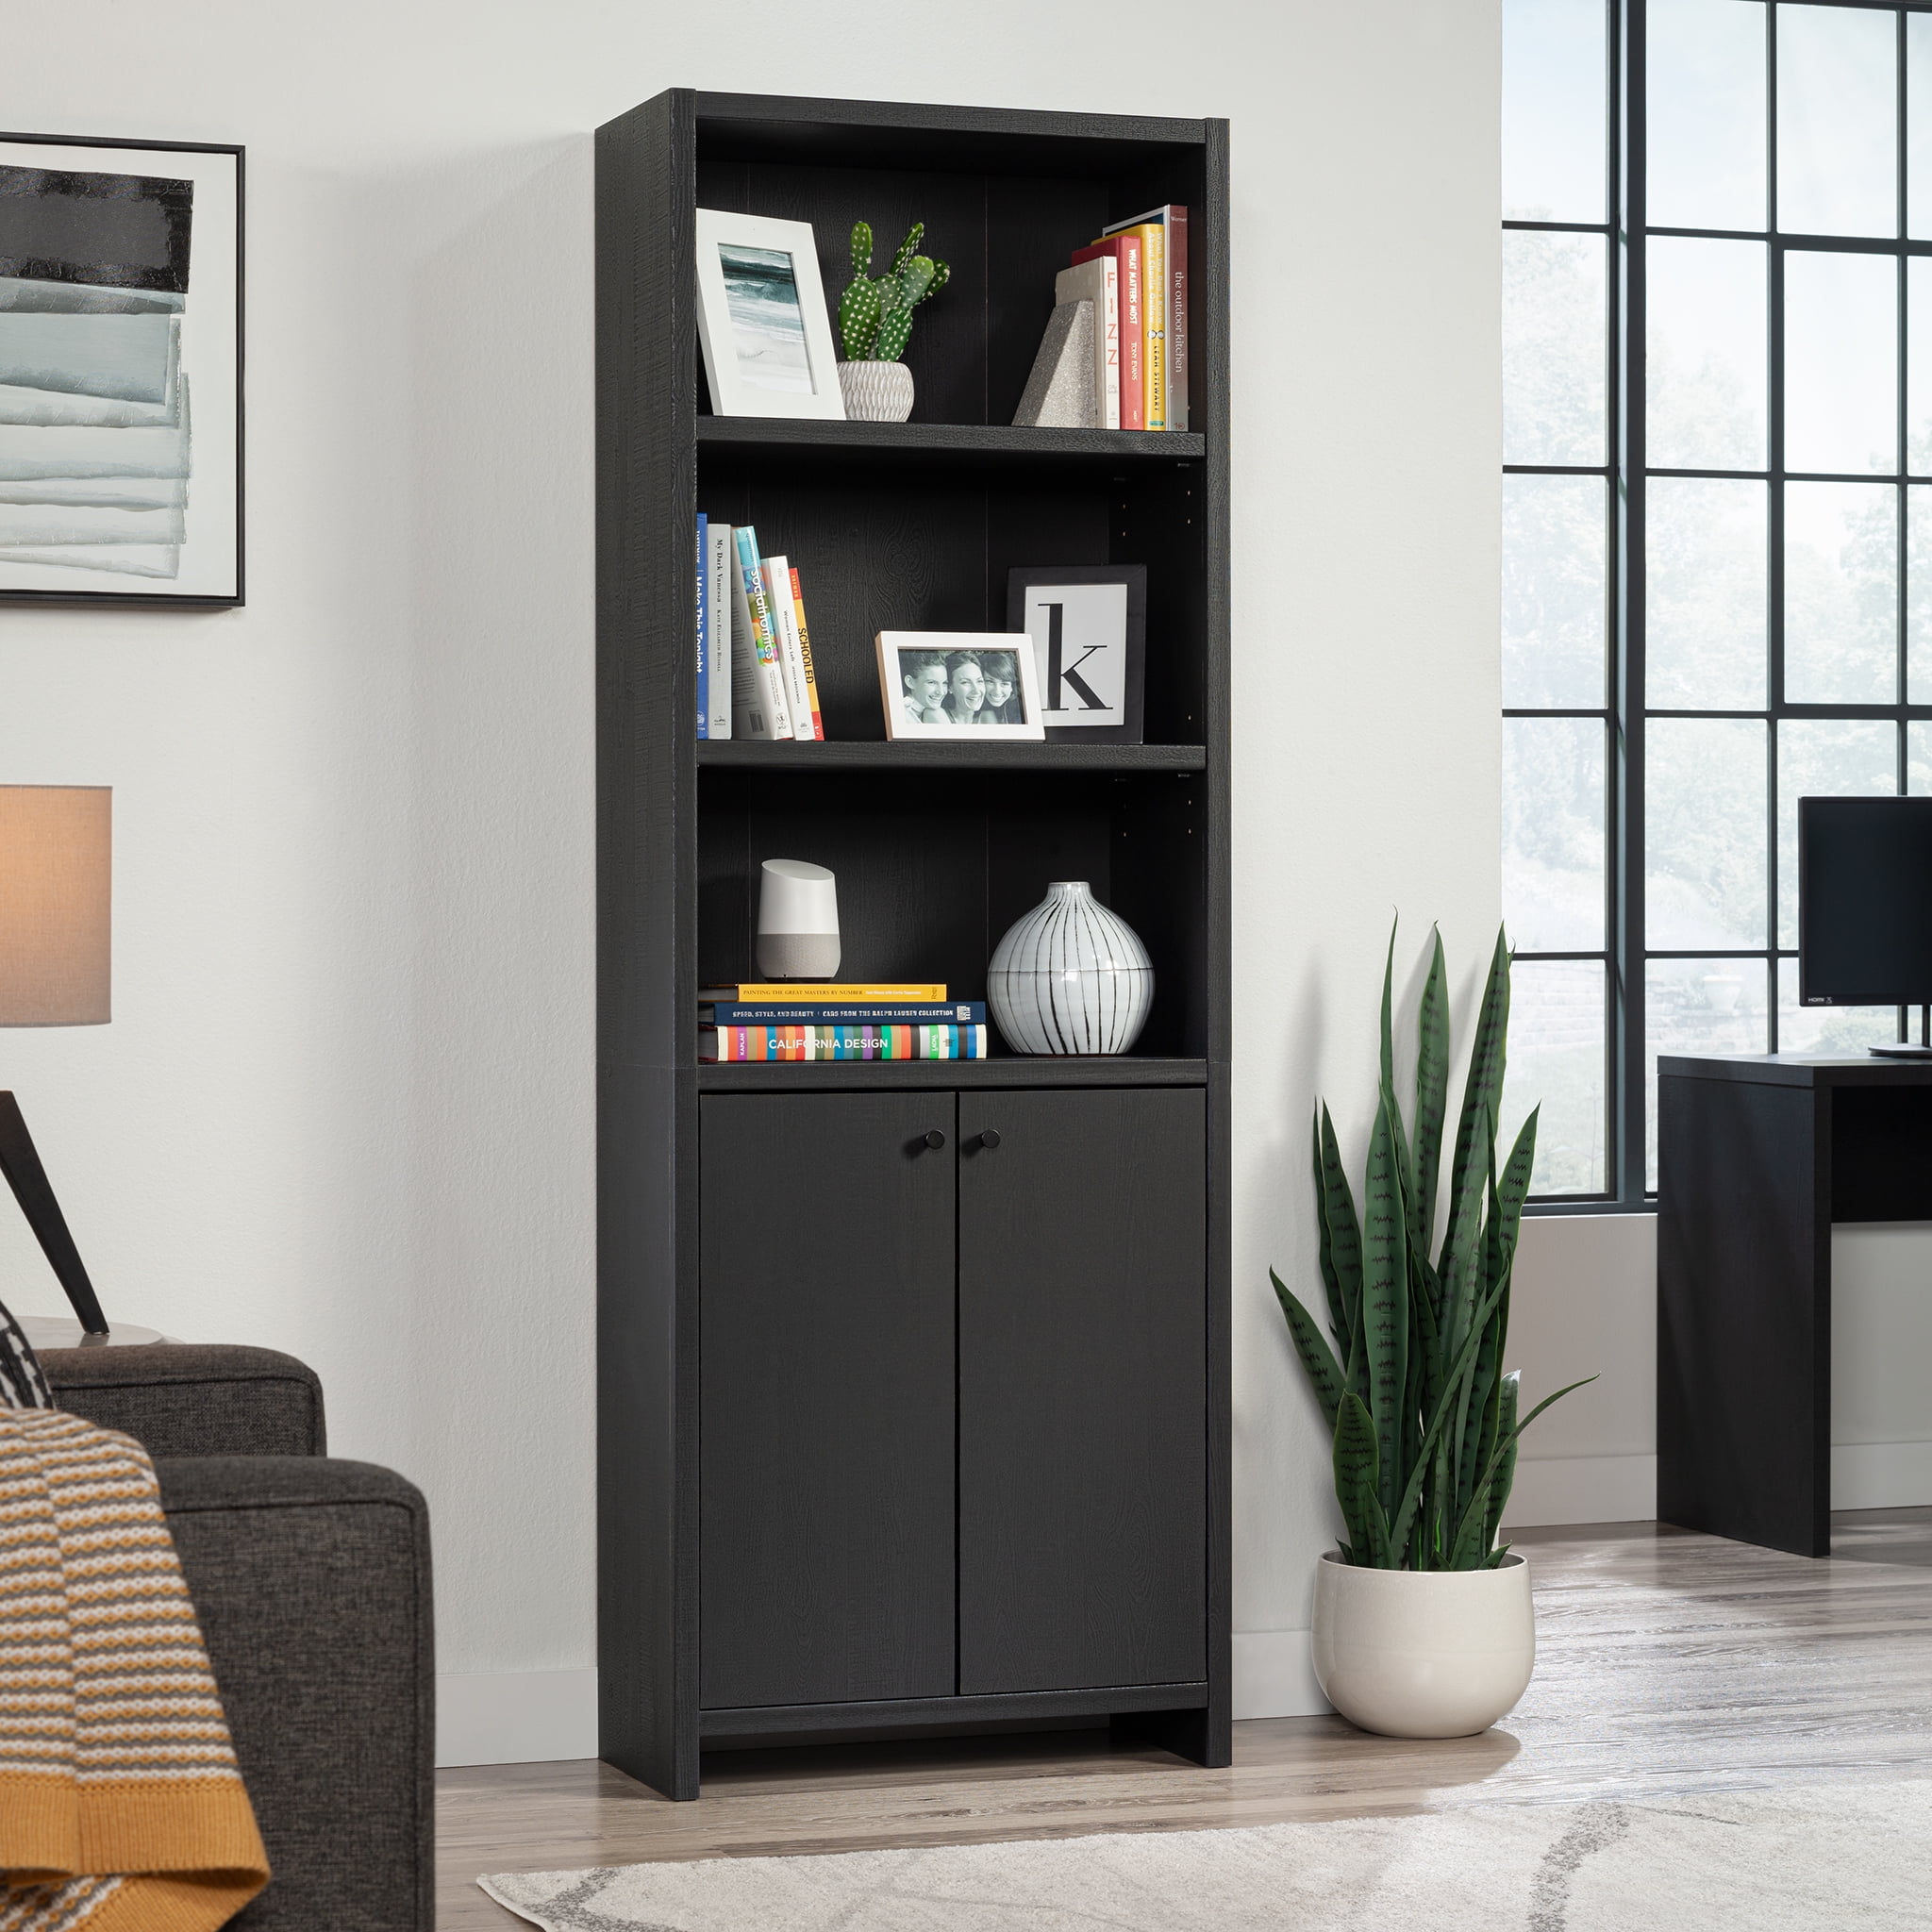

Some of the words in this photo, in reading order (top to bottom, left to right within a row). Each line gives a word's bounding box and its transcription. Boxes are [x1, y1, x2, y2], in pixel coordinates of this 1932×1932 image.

[1128, 249, 1137, 269] WHAT
[1128, 272, 1137, 303] MATTERS
[1174, 272, 1184, 289] the
[1128, 305, 1138, 325] MOST
[1174, 291, 1185, 332] outdoor
[1174, 334, 1185, 374] kitchen
[715, 539, 723, 549] My
[750, 570, 774, 660] socialnomics
[798, 628, 813, 684] SCHOOLED
[1038, 603, 1113, 711] k
[844, 1038, 889, 1049] DESIGN
